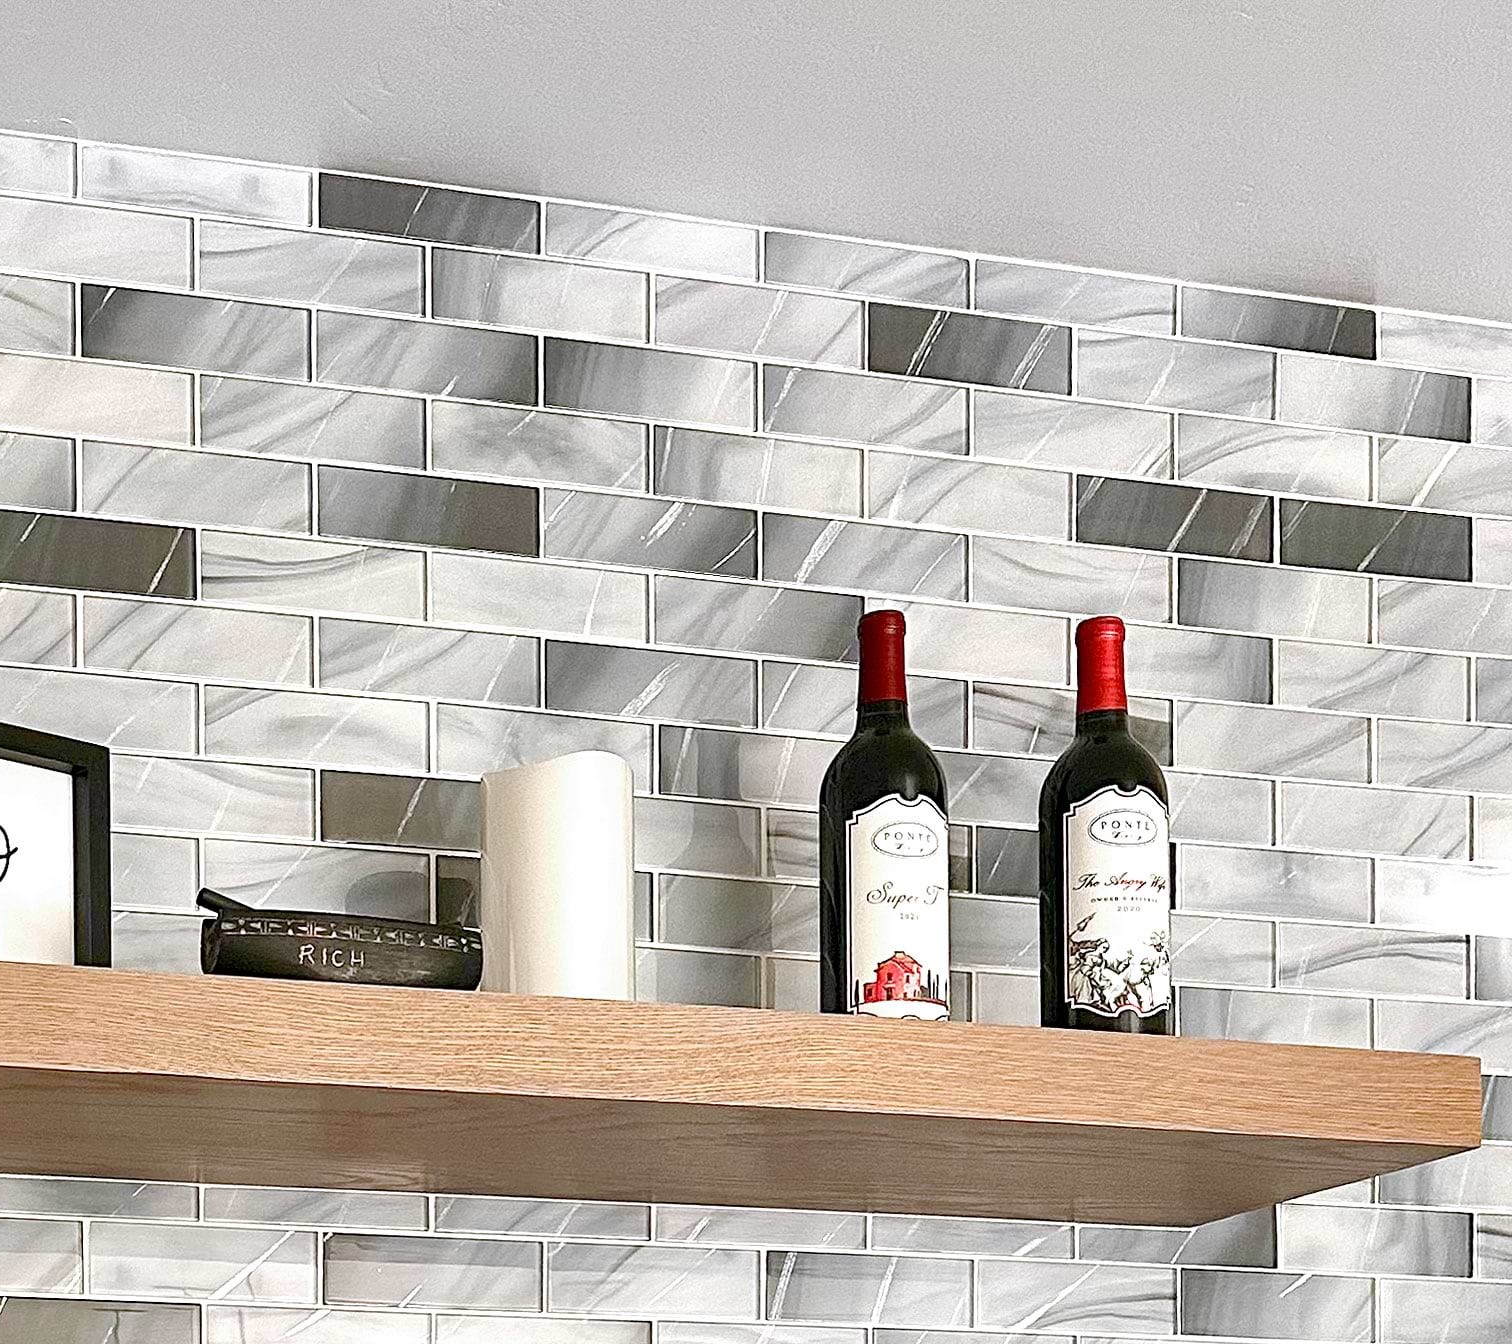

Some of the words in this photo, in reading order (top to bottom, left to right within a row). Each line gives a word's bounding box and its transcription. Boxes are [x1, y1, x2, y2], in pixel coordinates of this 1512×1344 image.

[1099, 820, 1151, 831] PONTE
[883, 832, 932, 844] PONTE
[1072, 873, 1101, 892] The
[1103, 871, 1148, 892] Angry
[866, 881, 919, 910] Super
[298, 944, 365, 968] RICH
